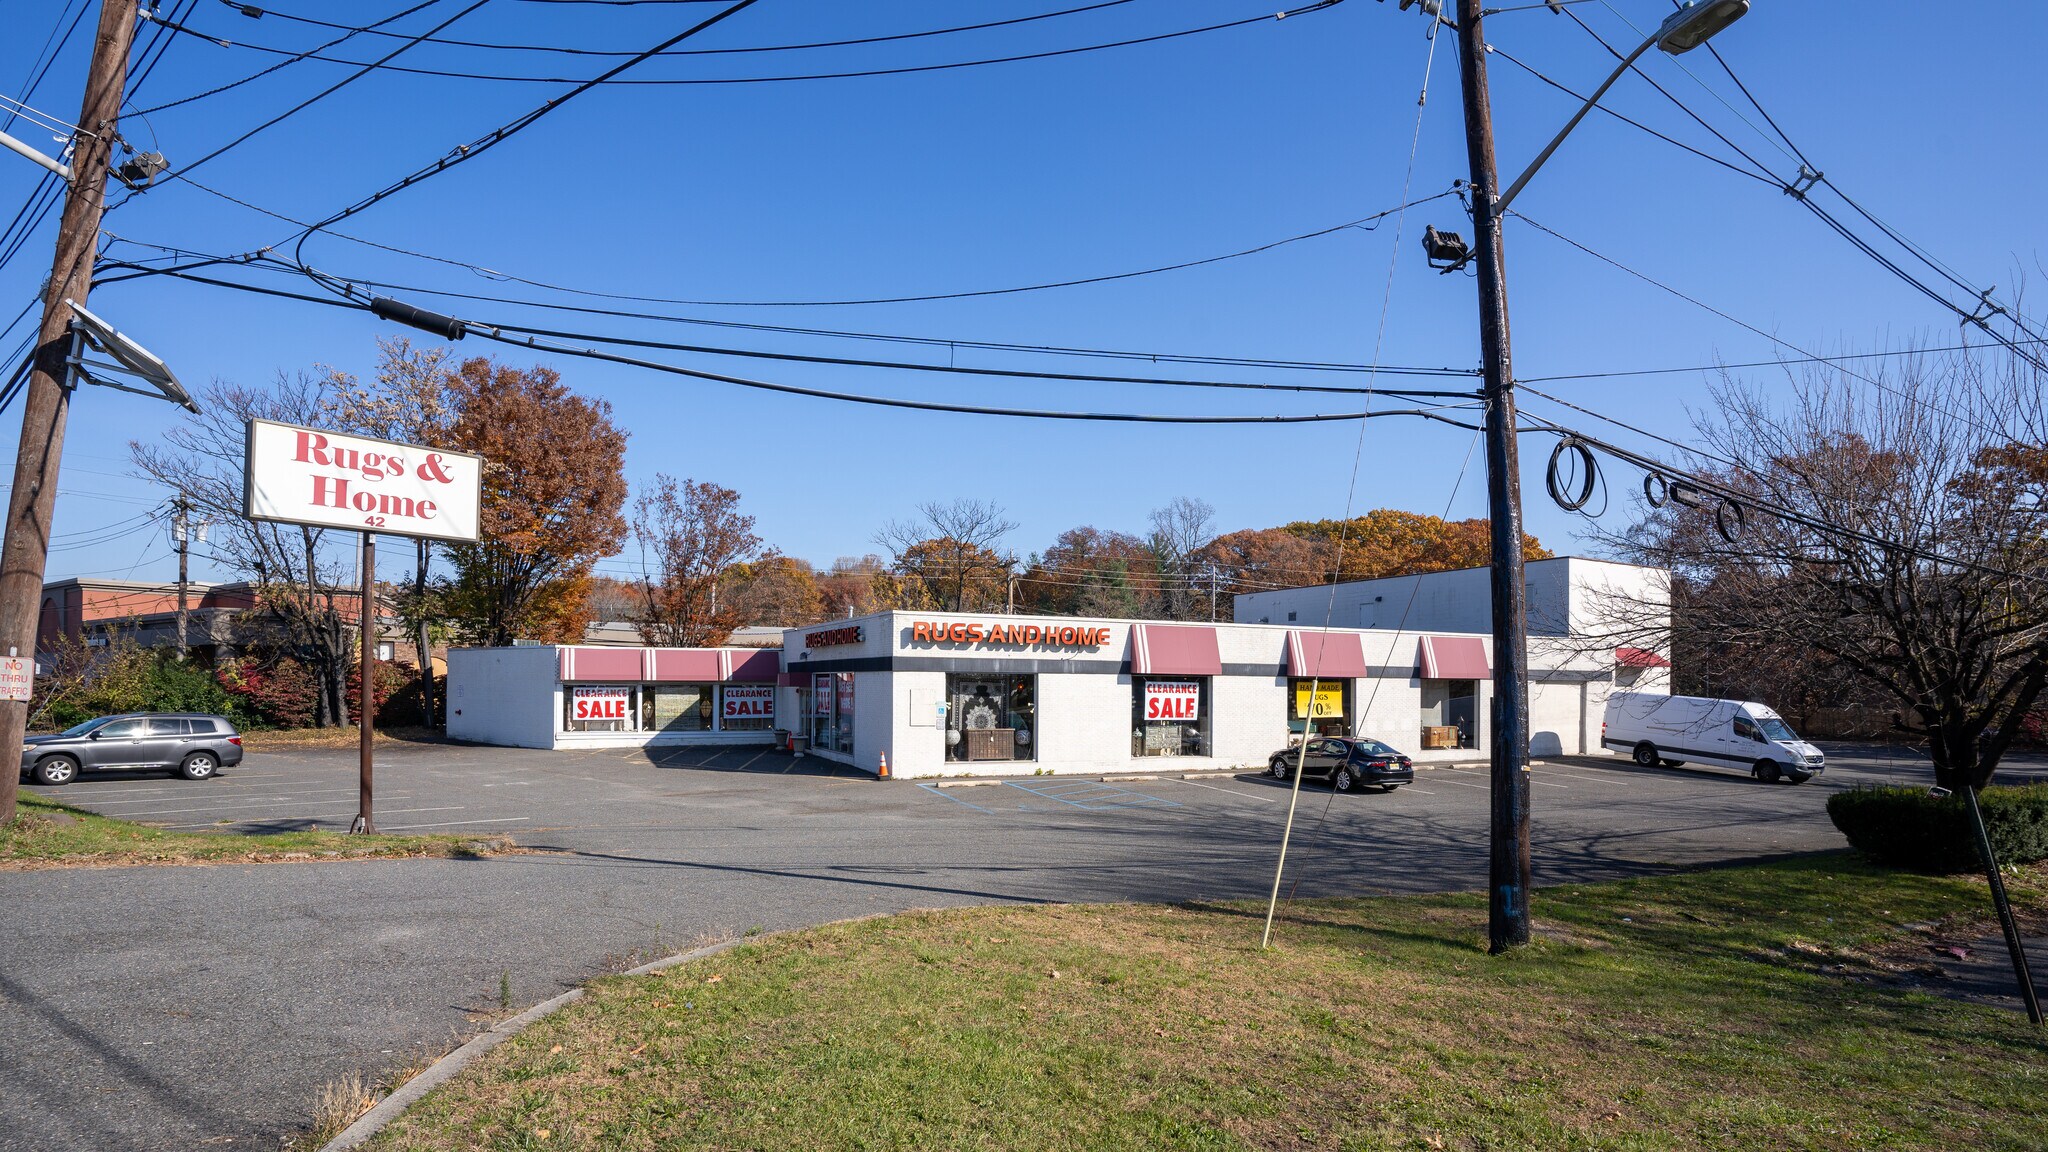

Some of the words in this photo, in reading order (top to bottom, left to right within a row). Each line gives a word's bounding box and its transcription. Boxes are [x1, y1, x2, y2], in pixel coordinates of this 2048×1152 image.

[291, 430, 404, 482] Rugs
[416, 453, 455, 484] &
[309, 475, 437, 520] Home
[364, 515, 386, 528] 42
[805, 631, 822, 648] RUGS
[822, 629, 836, 646] AND
[836, 626, 858, 645] HOME
[913, 621, 984, 643] RUGS
[988, 624, 1042, 645] AND
[1045, 626, 1111, 646] HOME
[5, 662, 23, 670] NO
[1, 674, 28, 683] THRU
[575, 689, 627, 698] CLEARANCE
[726, 690, 772, 698] CLEARANCE
[1147, 684, 1197, 694] CLEARANCE
[577, 700, 625, 718] SALE
[726, 701, 773, 715] SALE
[1148, 697, 1195, 718] SALE
